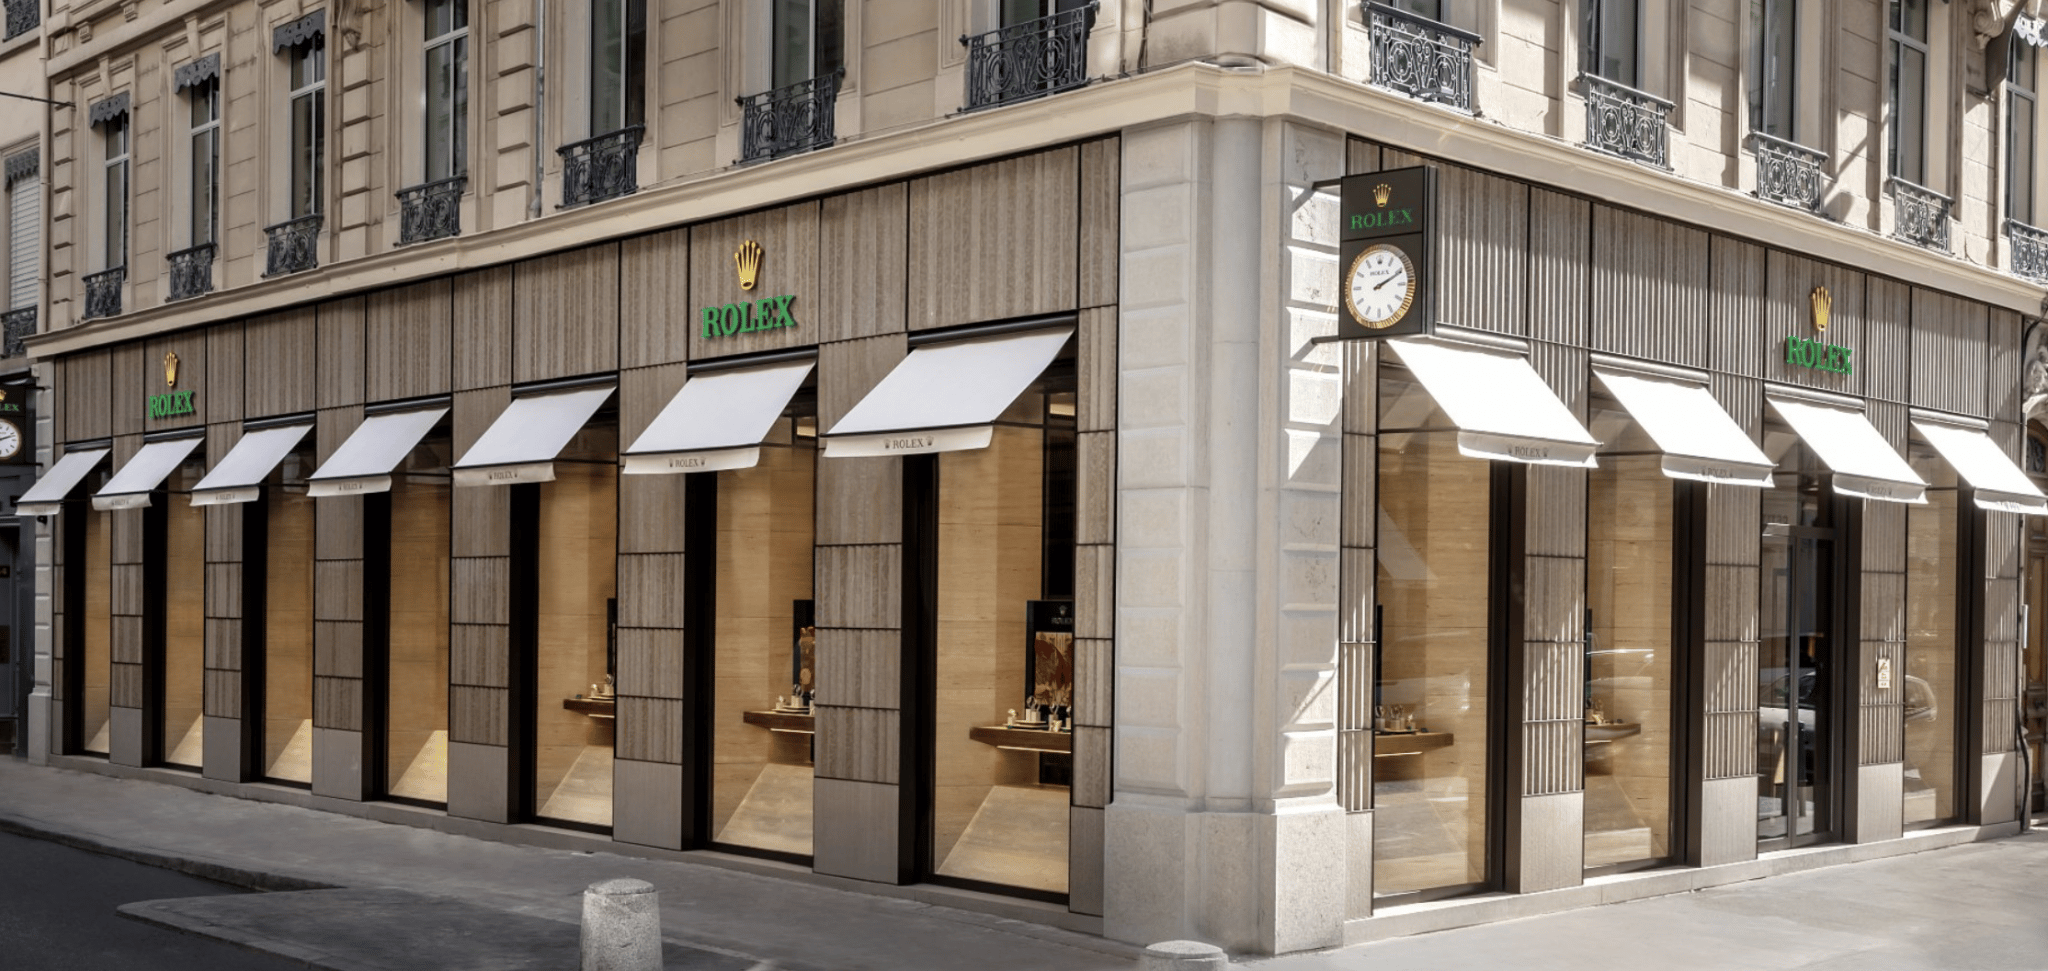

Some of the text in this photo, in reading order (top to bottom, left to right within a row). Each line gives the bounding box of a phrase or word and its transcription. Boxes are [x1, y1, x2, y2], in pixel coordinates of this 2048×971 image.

[1350, 209, 1413, 230] ROLEX
[701, 295, 796, 339] ROLEX
[1787, 336, 1852, 375] ROLEX
[149, 390, 193, 419] ROLEX
[893, 438, 924, 449] ROLEX
[1515, 446, 1541, 458] ROLEX
[675, 459, 699, 468] ROLEX
[493, 471, 513, 480] ROLEX
